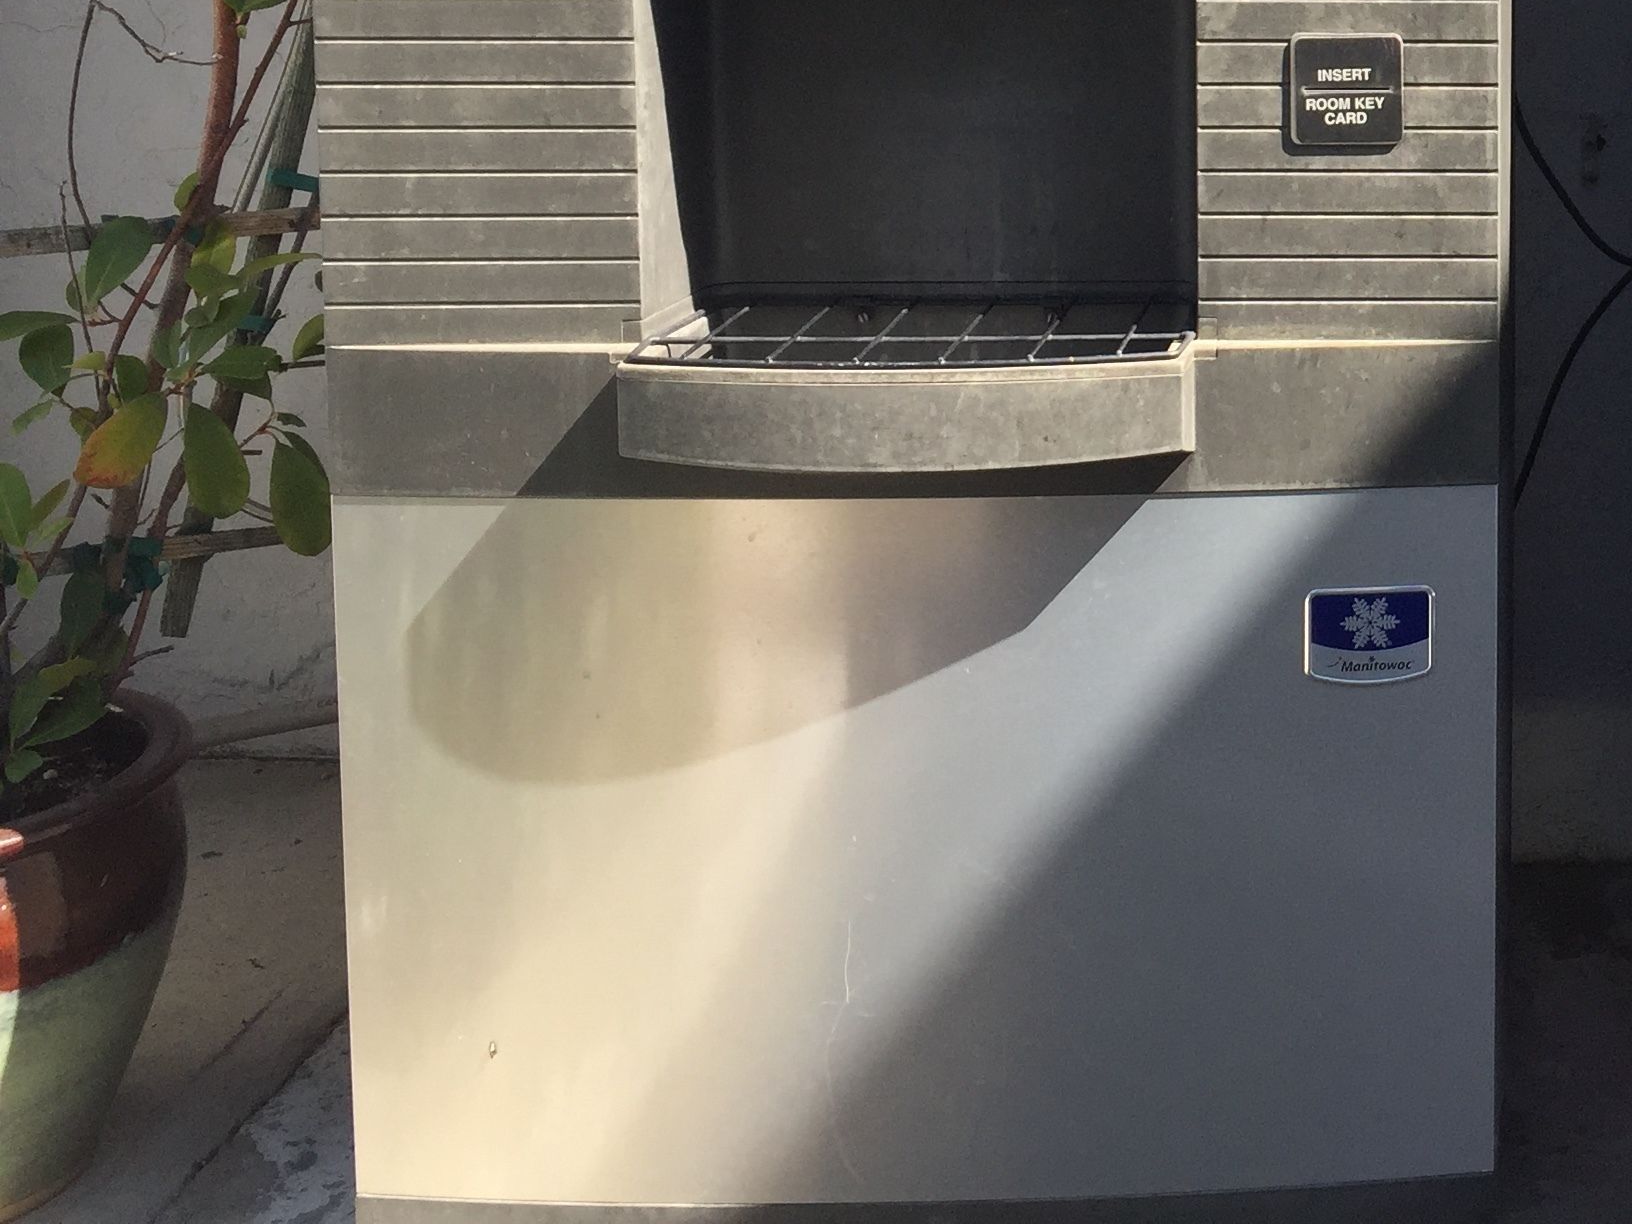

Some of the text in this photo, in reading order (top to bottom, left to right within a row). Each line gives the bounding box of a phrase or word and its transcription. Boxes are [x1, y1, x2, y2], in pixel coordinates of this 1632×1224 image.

[1317, 67, 1372, 82] INSERT
[1305, 96, 1385, 111] ROOM KEY
[1324, 111, 1368, 125] CARD
[1340, 657, 1413, 673] Manitowoc
